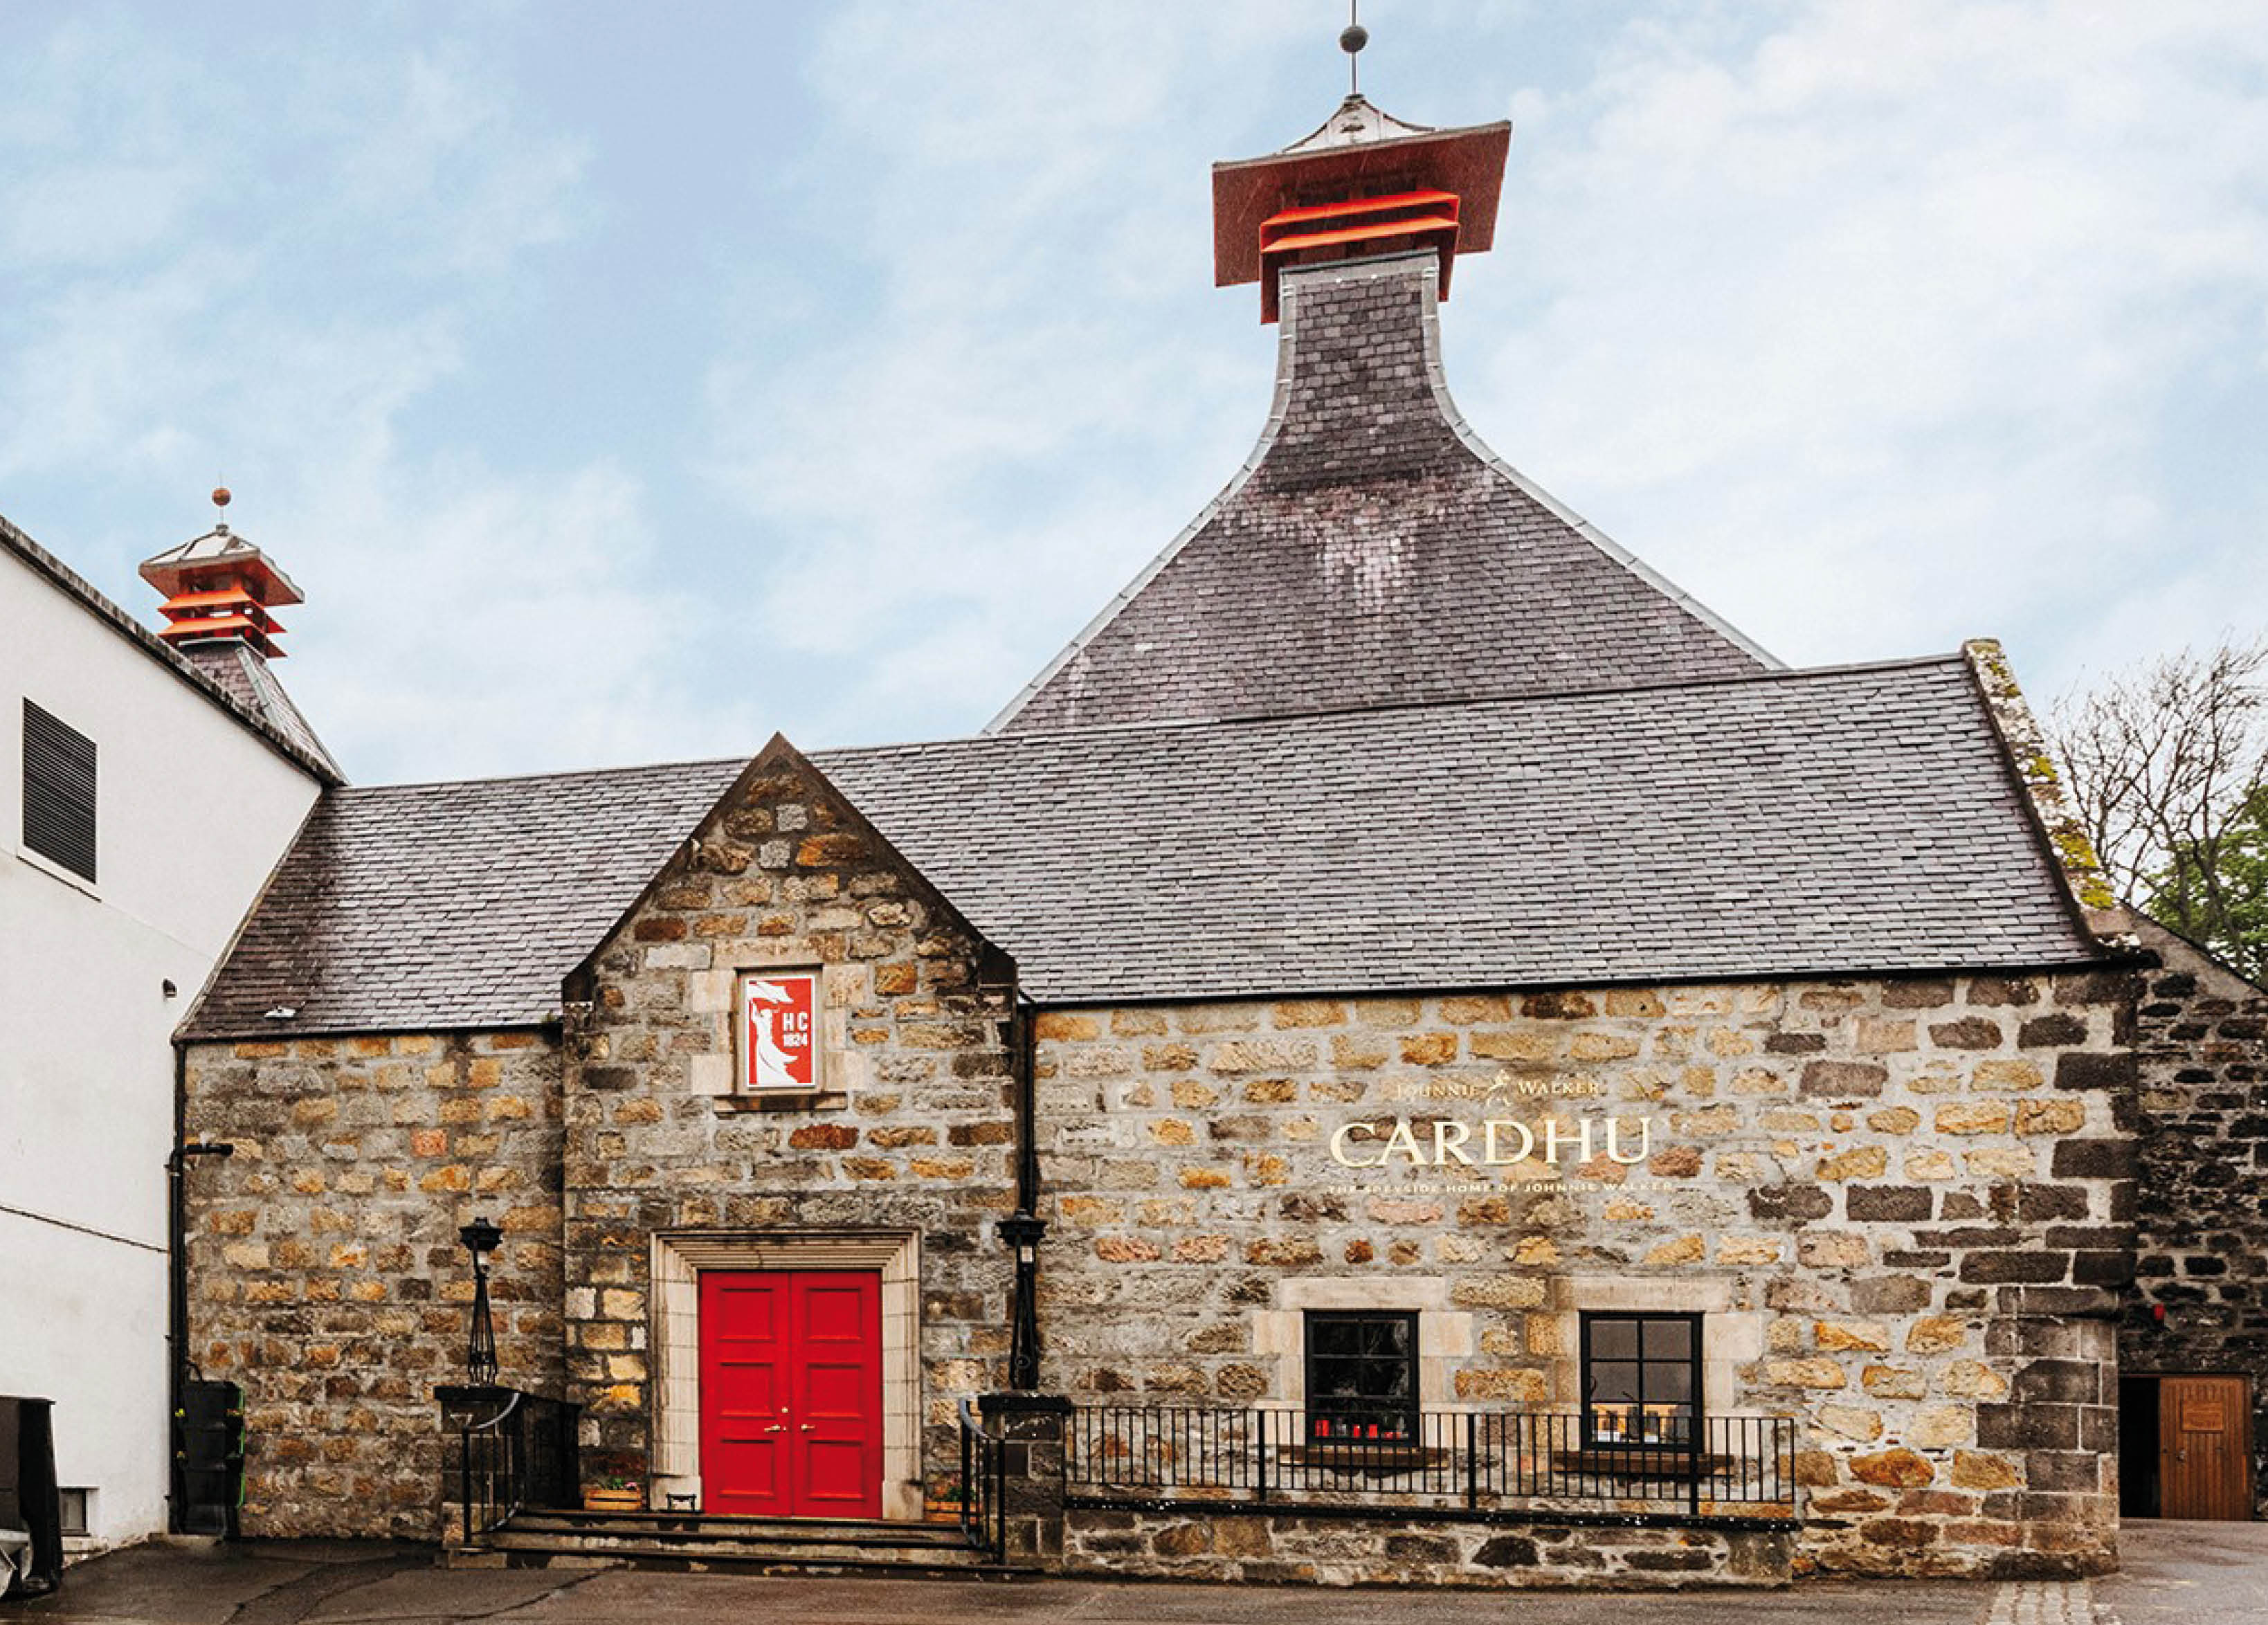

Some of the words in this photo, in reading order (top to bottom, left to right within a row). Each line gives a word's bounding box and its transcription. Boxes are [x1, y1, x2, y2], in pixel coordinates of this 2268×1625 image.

[1518, 1080, 1599, 1097] WALKER
[1330, 1117, 1651, 1167] CARDHU
[1446, 1183, 1491, 1193] HOME
[1498, 1183, 1518, 1193] OF
[1524, 1182, 1599, 1192] JOHNNIE
